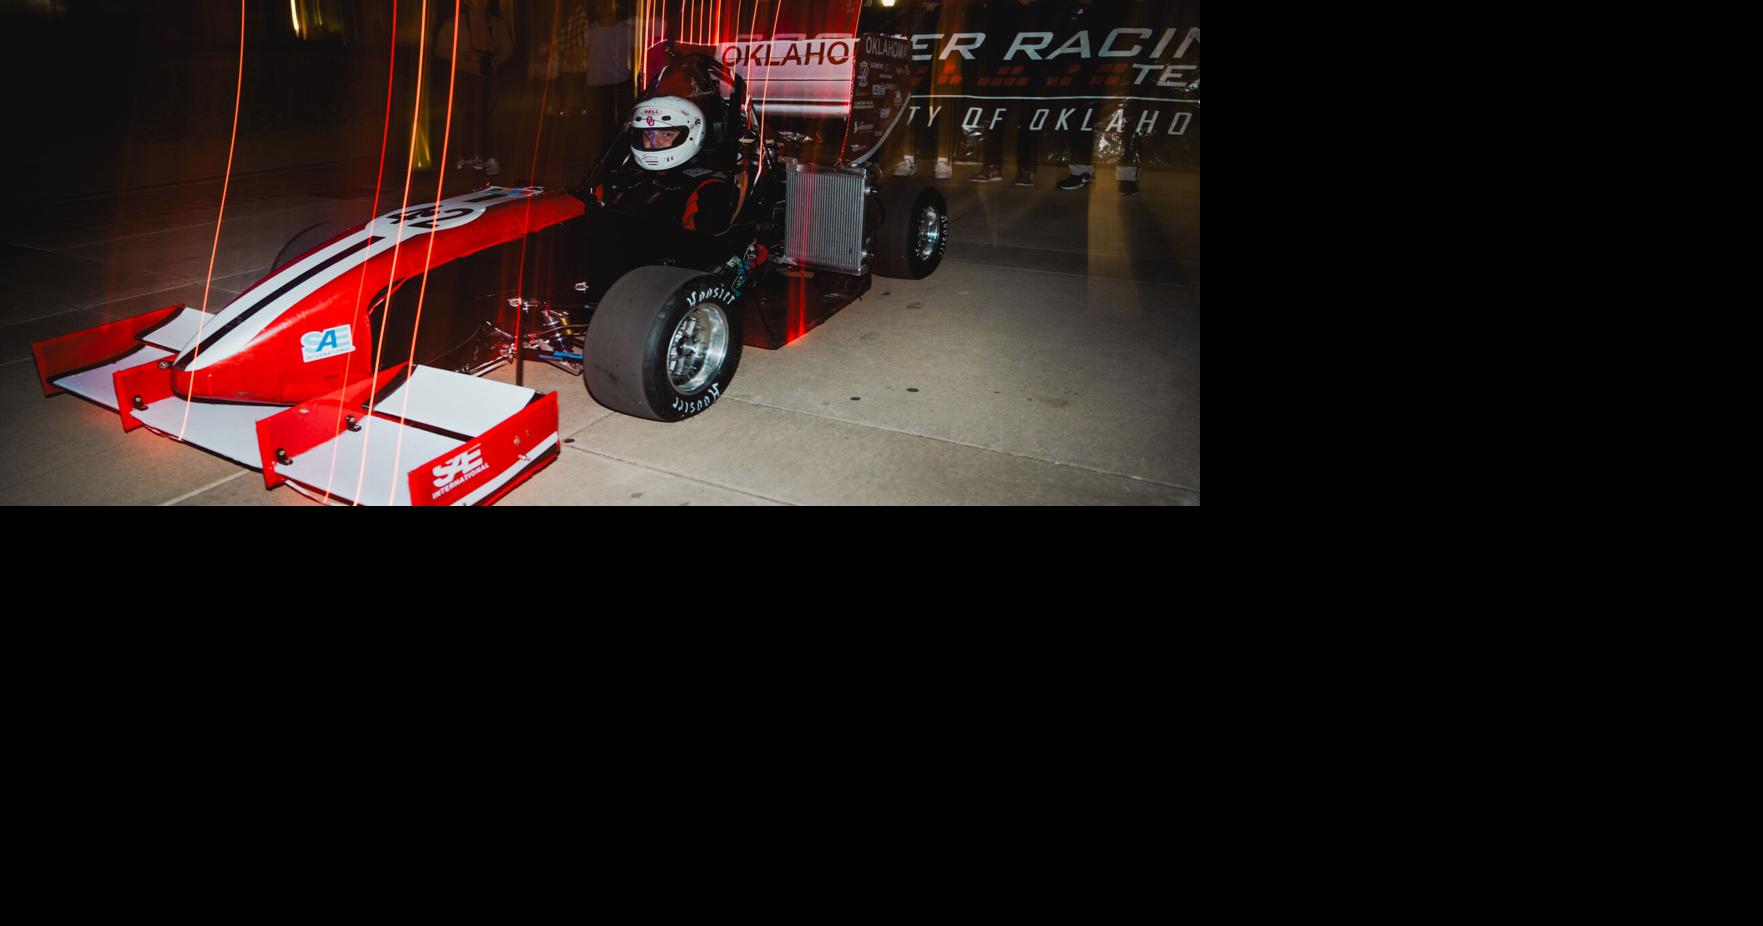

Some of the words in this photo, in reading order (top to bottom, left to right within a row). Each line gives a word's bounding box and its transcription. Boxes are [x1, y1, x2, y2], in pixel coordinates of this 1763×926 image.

[722, 41, 850, 67] OKLAHO
[961, 107, 1007, 130] OF
[386, 204, 475, 230] 42
[301, 325, 352, 354] SAE
[432, 442, 484, 488] SAE
[432, 462, 490, 500] INTERNATIONAL
